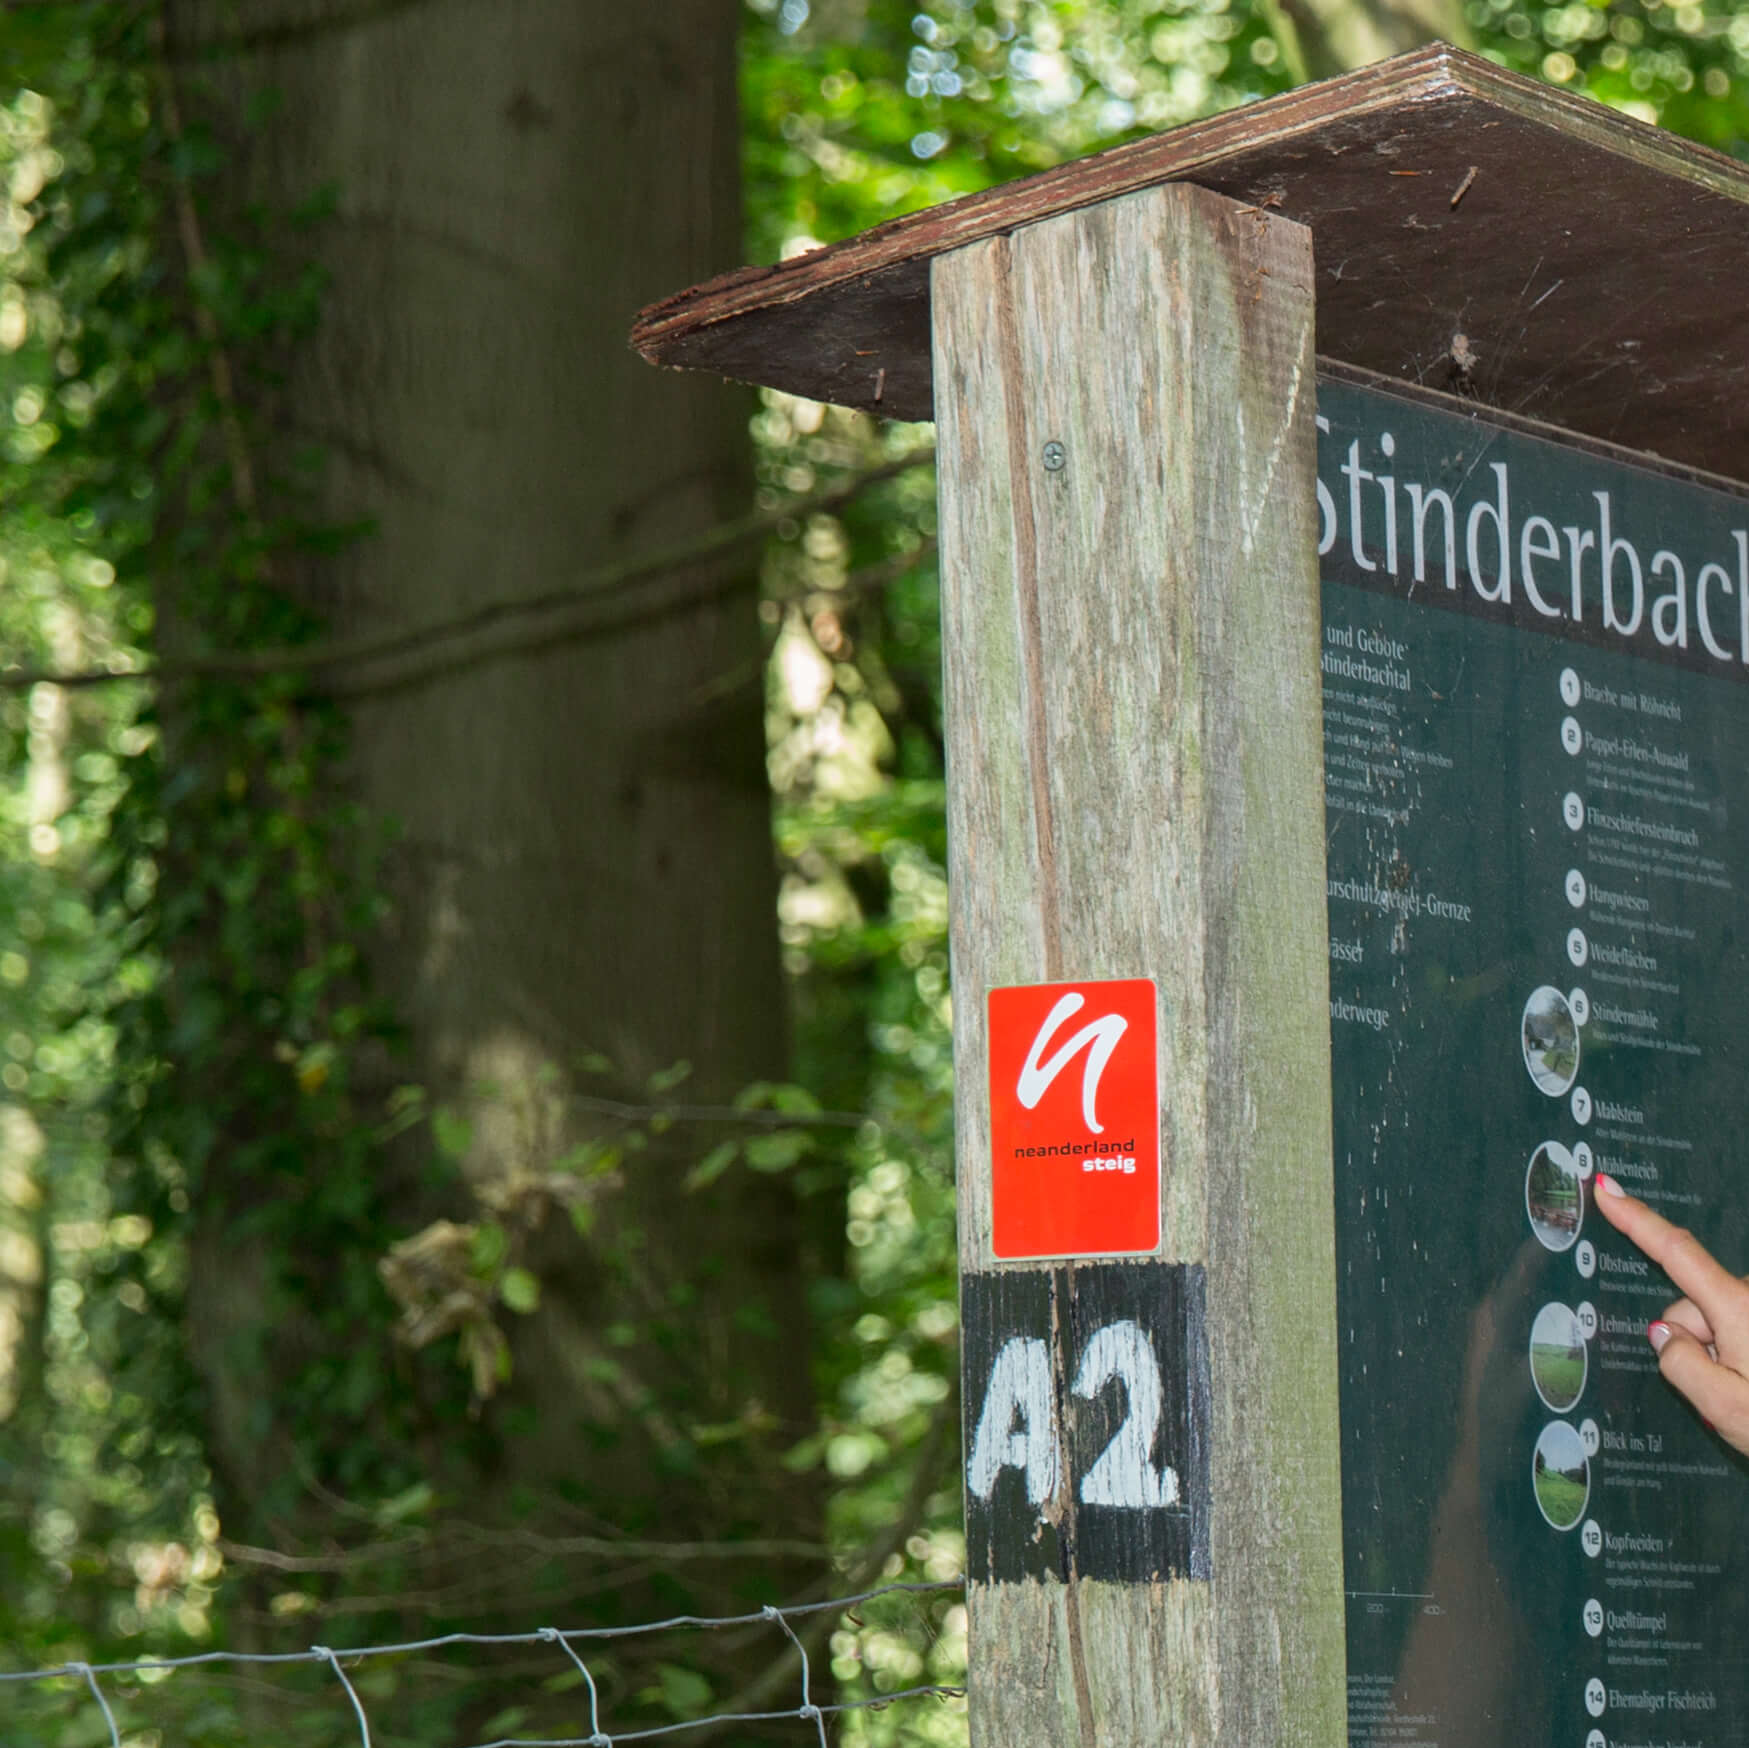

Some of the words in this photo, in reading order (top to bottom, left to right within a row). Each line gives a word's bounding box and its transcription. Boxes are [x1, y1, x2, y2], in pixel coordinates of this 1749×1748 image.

[1326, 625, 1353, 648] und
[1583, 680, 1618, 706] Brache
[1620, 692, 1637, 711] mit
[1640, 694, 1682, 721] Röhricht
[1588, 883, 1650, 911] Hangwiesen
[1330, 936, 1364, 963] ässer
[1590, 942, 1658, 971] Weideflächen
[1330, 996, 1390, 1031] nderwege
[1592, 1002, 1659, 1030] Stindermühle
[1594, 1099, 1645, 1124] Mahlstein
[1014, 1138, 1135, 1159] neanderland
[1082, 1154, 1137, 1174] steig
[1596, 1154, 1659, 1180] Mühlenteich
[1599, 1252, 1649, 1276] Obstwiese
[1600, 1314, 1649, 1336] Lehmkuhl
[966, 1319, 1182, 1509] A2
[1603, 1431, 1626, 1449] Blick
[1630, 1433, 1645, 1450] ins
[1646, 1434, 1663, 1452] Tal
[1604, 1531, 1664, 1554] Kopfweiden
[1606, 1611, 1667, 1634] Quelltümpel
[1609, 1689, 1666, 1713] Ehemaliger
[1667, 1690, 1718, 1710] Fischteich
